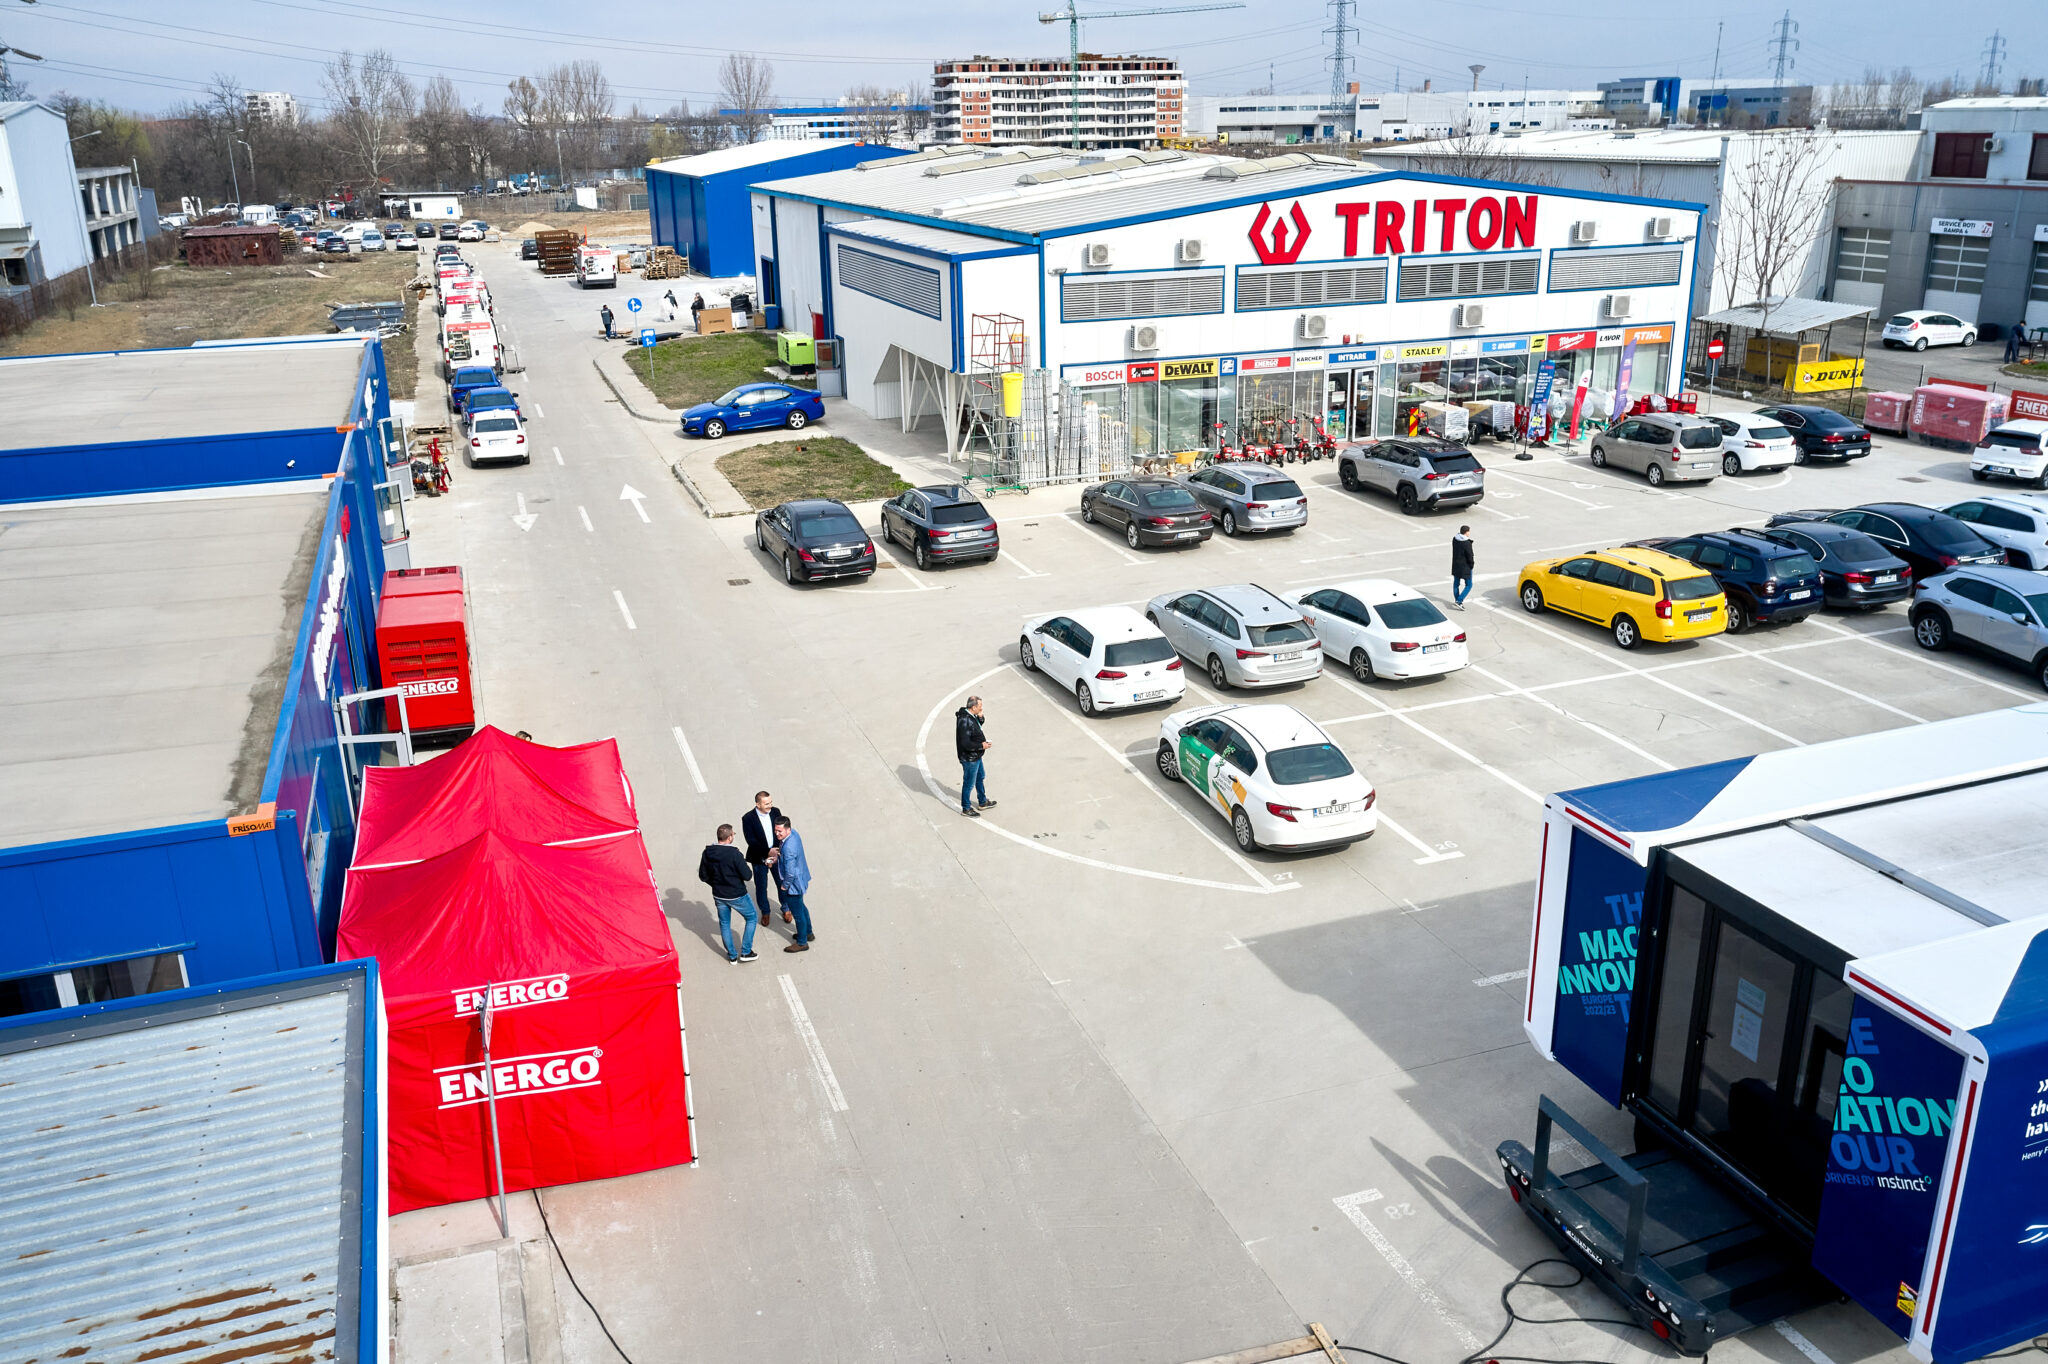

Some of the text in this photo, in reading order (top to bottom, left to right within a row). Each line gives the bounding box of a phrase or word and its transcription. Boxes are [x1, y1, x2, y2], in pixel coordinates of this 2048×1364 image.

[1335, 195, 1539, 257] TRITON
[1938, 220, 1961, 228] SERVICE
[1599, 334, 1621, 342] LAVOR
[1633, 330, 1663, 341] STIHL
[1338, 353, 1367, 362] INTRARE
[1406, 347, 1442, 357] STANLEY
[1254, 359, 1279, 368] ENERGO
[1085, 370, 1123, 382] BOSCH
[1914, 394, 1925, 424] ENERGO
[2016, 399, 2048, 416] ENER
[402, 680, 459, 696] ENERGO
[1326, 806, 1333, 814] 42
[1335, 804, 1347, 813] LUP
[1435, 840, 1459, 852] 26
[1273, 871, 1294, 882] 27
[1579, 926, 1641, 962] MAC
[1581, 994, 1614, 1005] EUROPE
[1584, 1004, 1617, 1017] 2022/23
[1840, 1057, 1875, 1094] O
[2030, 1099, 2048, 1118] th
[1833, 1095, 1957, 1137] ATION
[1827, 1133, 1922, 1176] OUR
[2021, 1149, 2043, 1161] Henry
[1861, 1174, 1875, 1187] BY
[1876, 1175, 1927, 1192] instinct
